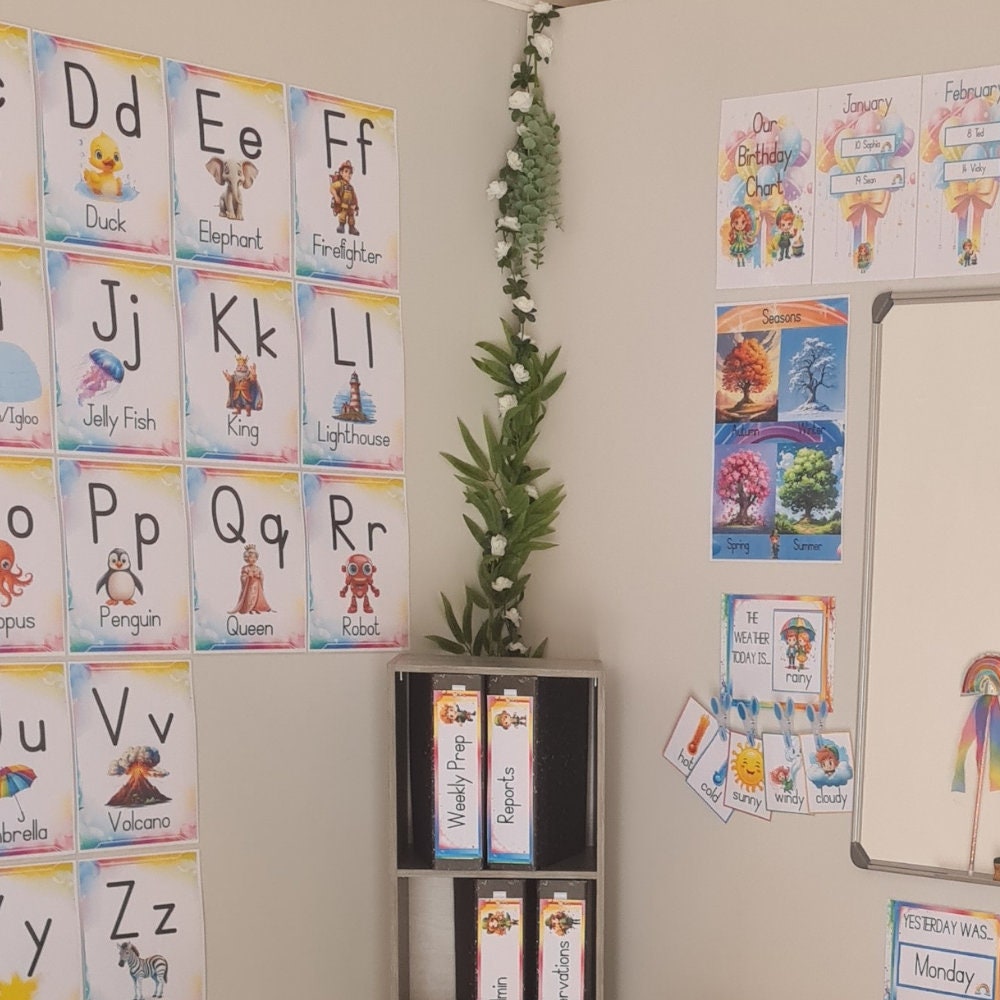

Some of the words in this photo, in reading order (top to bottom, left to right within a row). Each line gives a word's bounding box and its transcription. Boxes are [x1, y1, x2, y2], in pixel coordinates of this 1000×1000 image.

[64, 61, 141, 138] Dd
[842, 93, 892, 116] January
[196, 88, 262, 160] Ee
[752, 112, 777, 134] Our
[974, 128, 984, 137] Ted
[323, 109, 374, 175] Ff
[738, 144, 792, 172] Birthday
[746, 175, 784, 197] Chart
[85, 204, 126, 233] Duck
[199, 219, 263, 253] Elephant
[312, 233, 382, 269] Firefighter
[92, 279, 141, 371] Jj
[210, 292, 277, 359] Kk
[762, 308, 802, 325] Seasons
[83, 404, 118, 437] Jelly
[124, 406, 156, 431] Fish
[227, 415, 259, 446] King
[317, 425, 390, 451] Lighthouse
[88, 483, 160, 571] Pp
[211, 485, 288, 569] Qq
[329, 495, 387, 551] Rr
[727, 538, 749, 555] Spring
[793, 539, 822, 551] Summer
[99, 606, 161, 636] Penguin
[226, 615, 273, 637] Queen
[342, 617, 381, 637] Robot
[747, 612, 758, 624] THE
[735, 632, 769, 644] WEATHER
[732, 651, 756, 664] TODAY
[786, 672, 812, 689] rainy
[447, 735, 473, 771] Prep
[447, 773, 473, 829] Weekly
[497, 767, 517, 824] Reports
[701, 782, 722, 803] cold
[733, 792, 762, 812] sunny
[775, 790, 804, 810] windy
[816, 787, 847, 809] cloudy
[108, 811, 171, 832] Volcano
[903, 913, 957, 936] YESTERDAY
[914, 953, 975, 993] Monday
